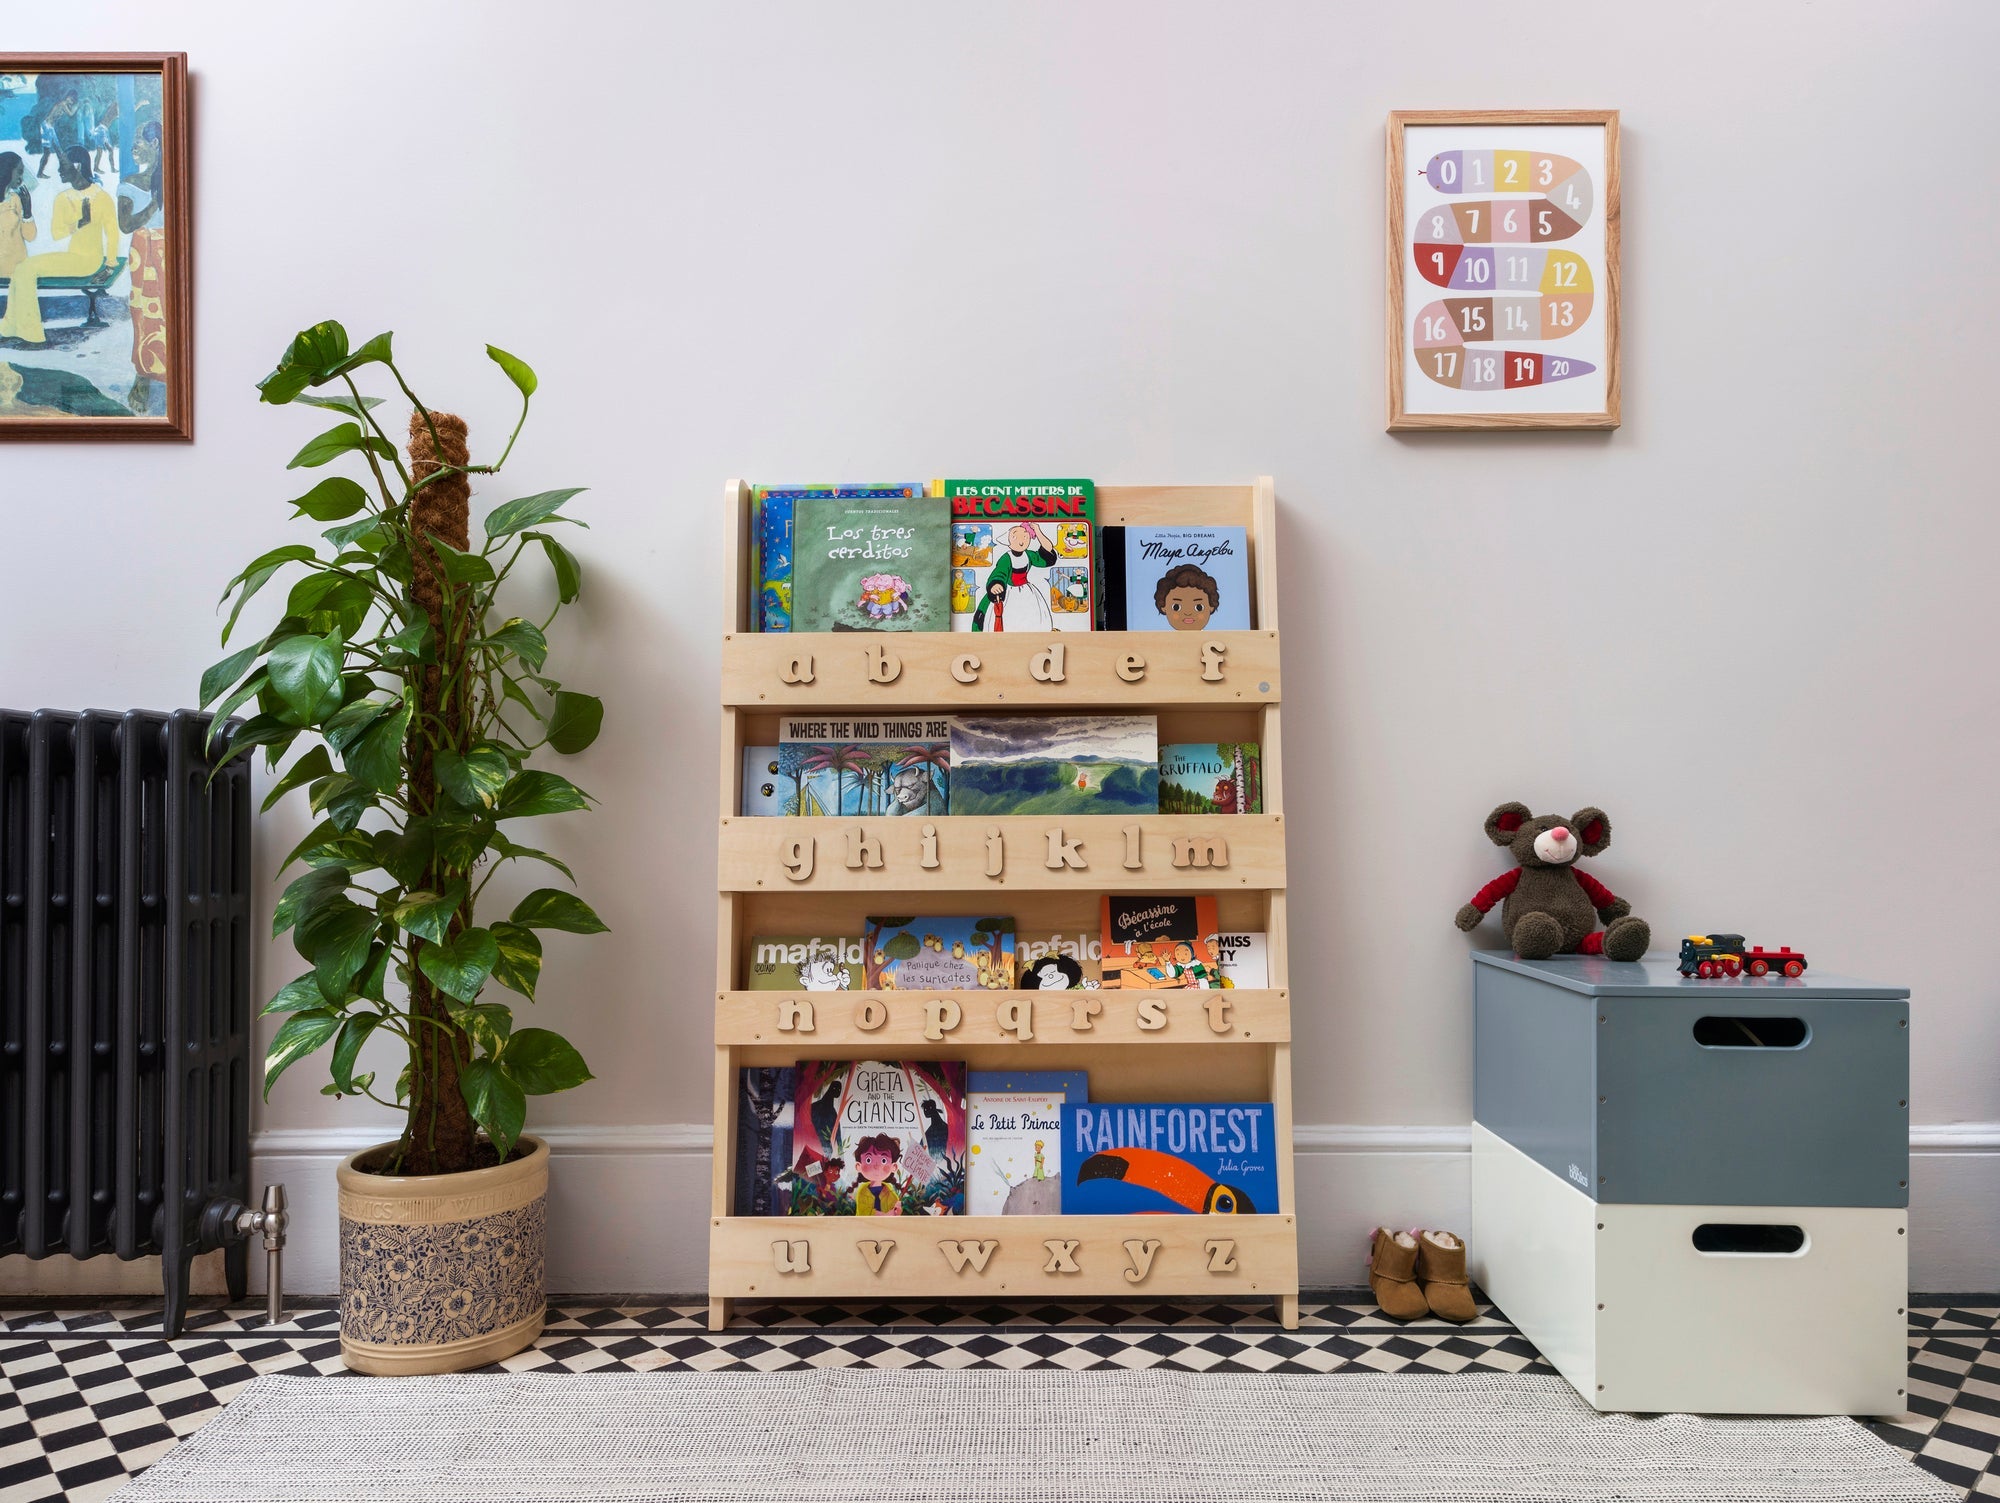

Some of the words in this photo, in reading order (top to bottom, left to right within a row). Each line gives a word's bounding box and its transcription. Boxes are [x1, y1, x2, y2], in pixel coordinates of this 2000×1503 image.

[1440, 159, 1457, 185] 0
[1472, 159, 1486, 185] 1
[1503, 159, 1519, 184] 2
[1538, 159, 1553, 185] 3
[1566, 184, 1581, 210] 4
[1432, 216, 1445, 239] 8
[1466, 209, 1480, 234] 7
[1503, 209, 1518, 233] 6
[1538, 211, 1553, 235] 5
[1431, 252, 1444, 276] 9
[1464, 257, 1490, 283] 10
[1507, 256, 1528, 283] 11
[1552, 262, 1578, 287] 12
[1423, 316, 1446, 341] 16
[1461, 306, 1486, 333] 15
[1505, 306, 1528, 331] 14
[1548, 301, 1574, 327] 13
[1433, 352, 1457, 378] 17
[1473, 357, 1496, 383] 18
[1514, 357, 1534, 381] 19
[1551, 360, 1570, 376] 20
[956, 486, 978, 496] LES
[981, 486, 1012, 496] CENT
[1015, 486, 1065, 496] METIERS
[1068, 486, 1083, 496] DE
[952, 496, 1087, 517] BECASSINE
[827, 526, 863, 541] Los
[870, 525, 915, 541] tres
[828, 541, 913, 559] cerditos
[1140, 539, 1185, 566] Maya
[1186, 540, 1233, 565] Angelou
[779, 655, 816, 684] a
[865, 645, 902, 683] b
[951, 654, 981, 683] c
[1029, 643, 1066, 682] d
[1115, 653, 1146, 682] e
[1200, 640, 1227, 681] f
[789, 723, 827, 738] WHERE
[829, 723, 849, 738] THE
[854, 722, 879, 738] WILD
[883, 722, 922, 738] THINGS
[926, 721, 947, 737] ARE
[1160, 762, 1222, 776] GRUFFALO
[780, 836, 816, 881] g
[845, 826, 884, 868] h
[920, 823, 940, 868] i
[985, 825, 1003, 877] j
[1045, 828, 1088, 869] k
[1122, 825, 1143, 869] l
[1171, 837, 1229, 868] m
[1118, 905, 1178, 930] Bécassine
[1133, 928, 1143, 938] à
[1143, 918, 1172, 932] l'école
[1218, 936, 1251, 947] MISS
[907, 961, 940, 971] Panique
[944, 961, 964, 970] chez
[1219, 950, 1236, 961] TY
[903, 974, 915, 982] les
[920, 972, 971, 984] suricates
[777, 1000, 816, 1032] n
[854, 999, 887, 1031] o
[923, 999, 962, 1041] p
[997, 999, 1033, 1041] q
[1070, 999, 1101, 1030] r
[1136, 999, 1167, 1030] s
[1203, 994, 1232, 1033] t
[857, 1071, 903, 1092] GRETA
[847, 1100, 915, 1124] GIANTS
[971, 1114, 984, 1130] Le
[989, 1114, 1017, 1130] Petit
[1021, 1113, 1060, 1130] Prince
[1075, 1108, 1262, 1153] RAINFOREST
[1218, 1158, 1239, 1175] Julia
[1241, 1160, 1264, 1176] Groves
[771, 1240, 811, 1273] u
[856, 1240, 896, 1273] v
[937, 1239, 999, 1273] w
[1043, 1239, 1080, 1272] x
[1122, 1239, 1161, 1283] y
[1204, 1239, 1238, 1272] z
